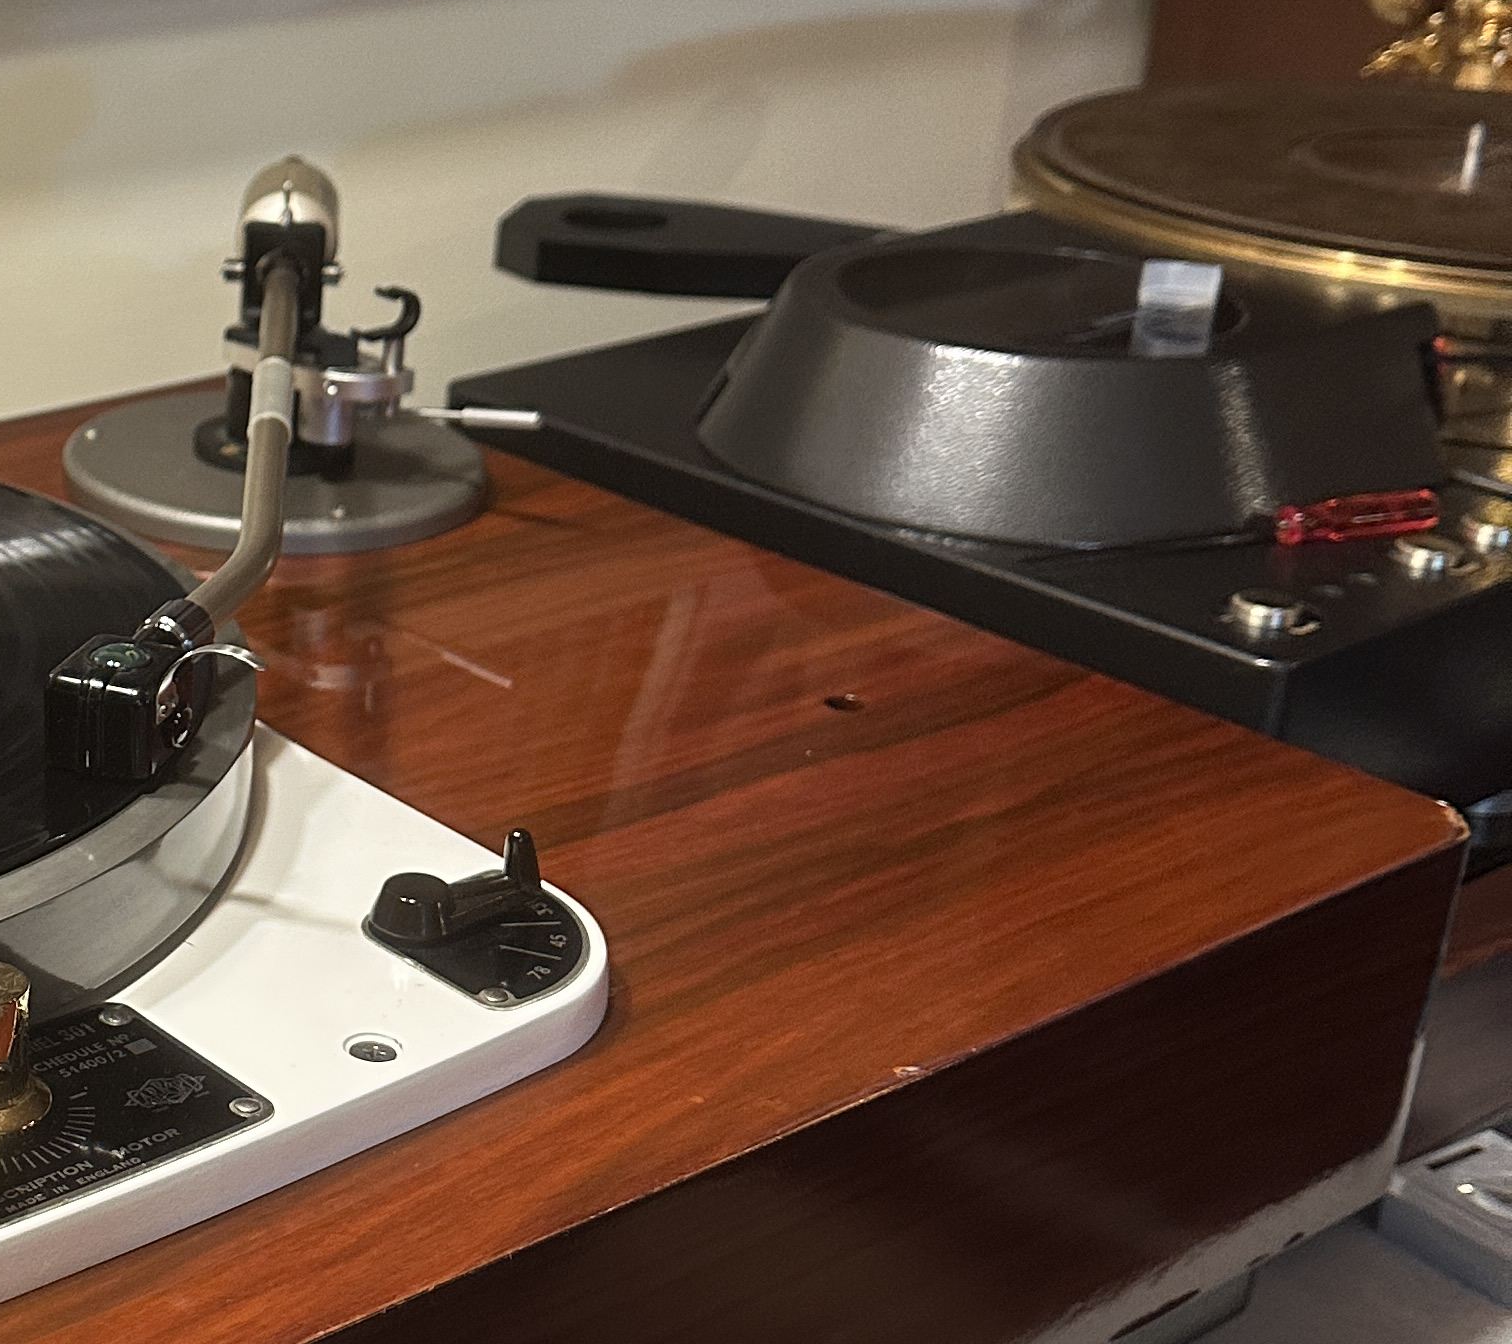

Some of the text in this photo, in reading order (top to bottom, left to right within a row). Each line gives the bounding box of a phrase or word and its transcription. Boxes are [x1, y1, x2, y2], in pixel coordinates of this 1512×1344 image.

[549, 933, 568, 949] 45
[526, 965, 551, 981] 78
[58, 1023, 96, 1042] 301
[32, 1041, 105, 1073] CHEDULE
[111, 1127, 181, 1160] MOTOR
[4, 1156, 143, 1214] MADE IN ENGLAND
